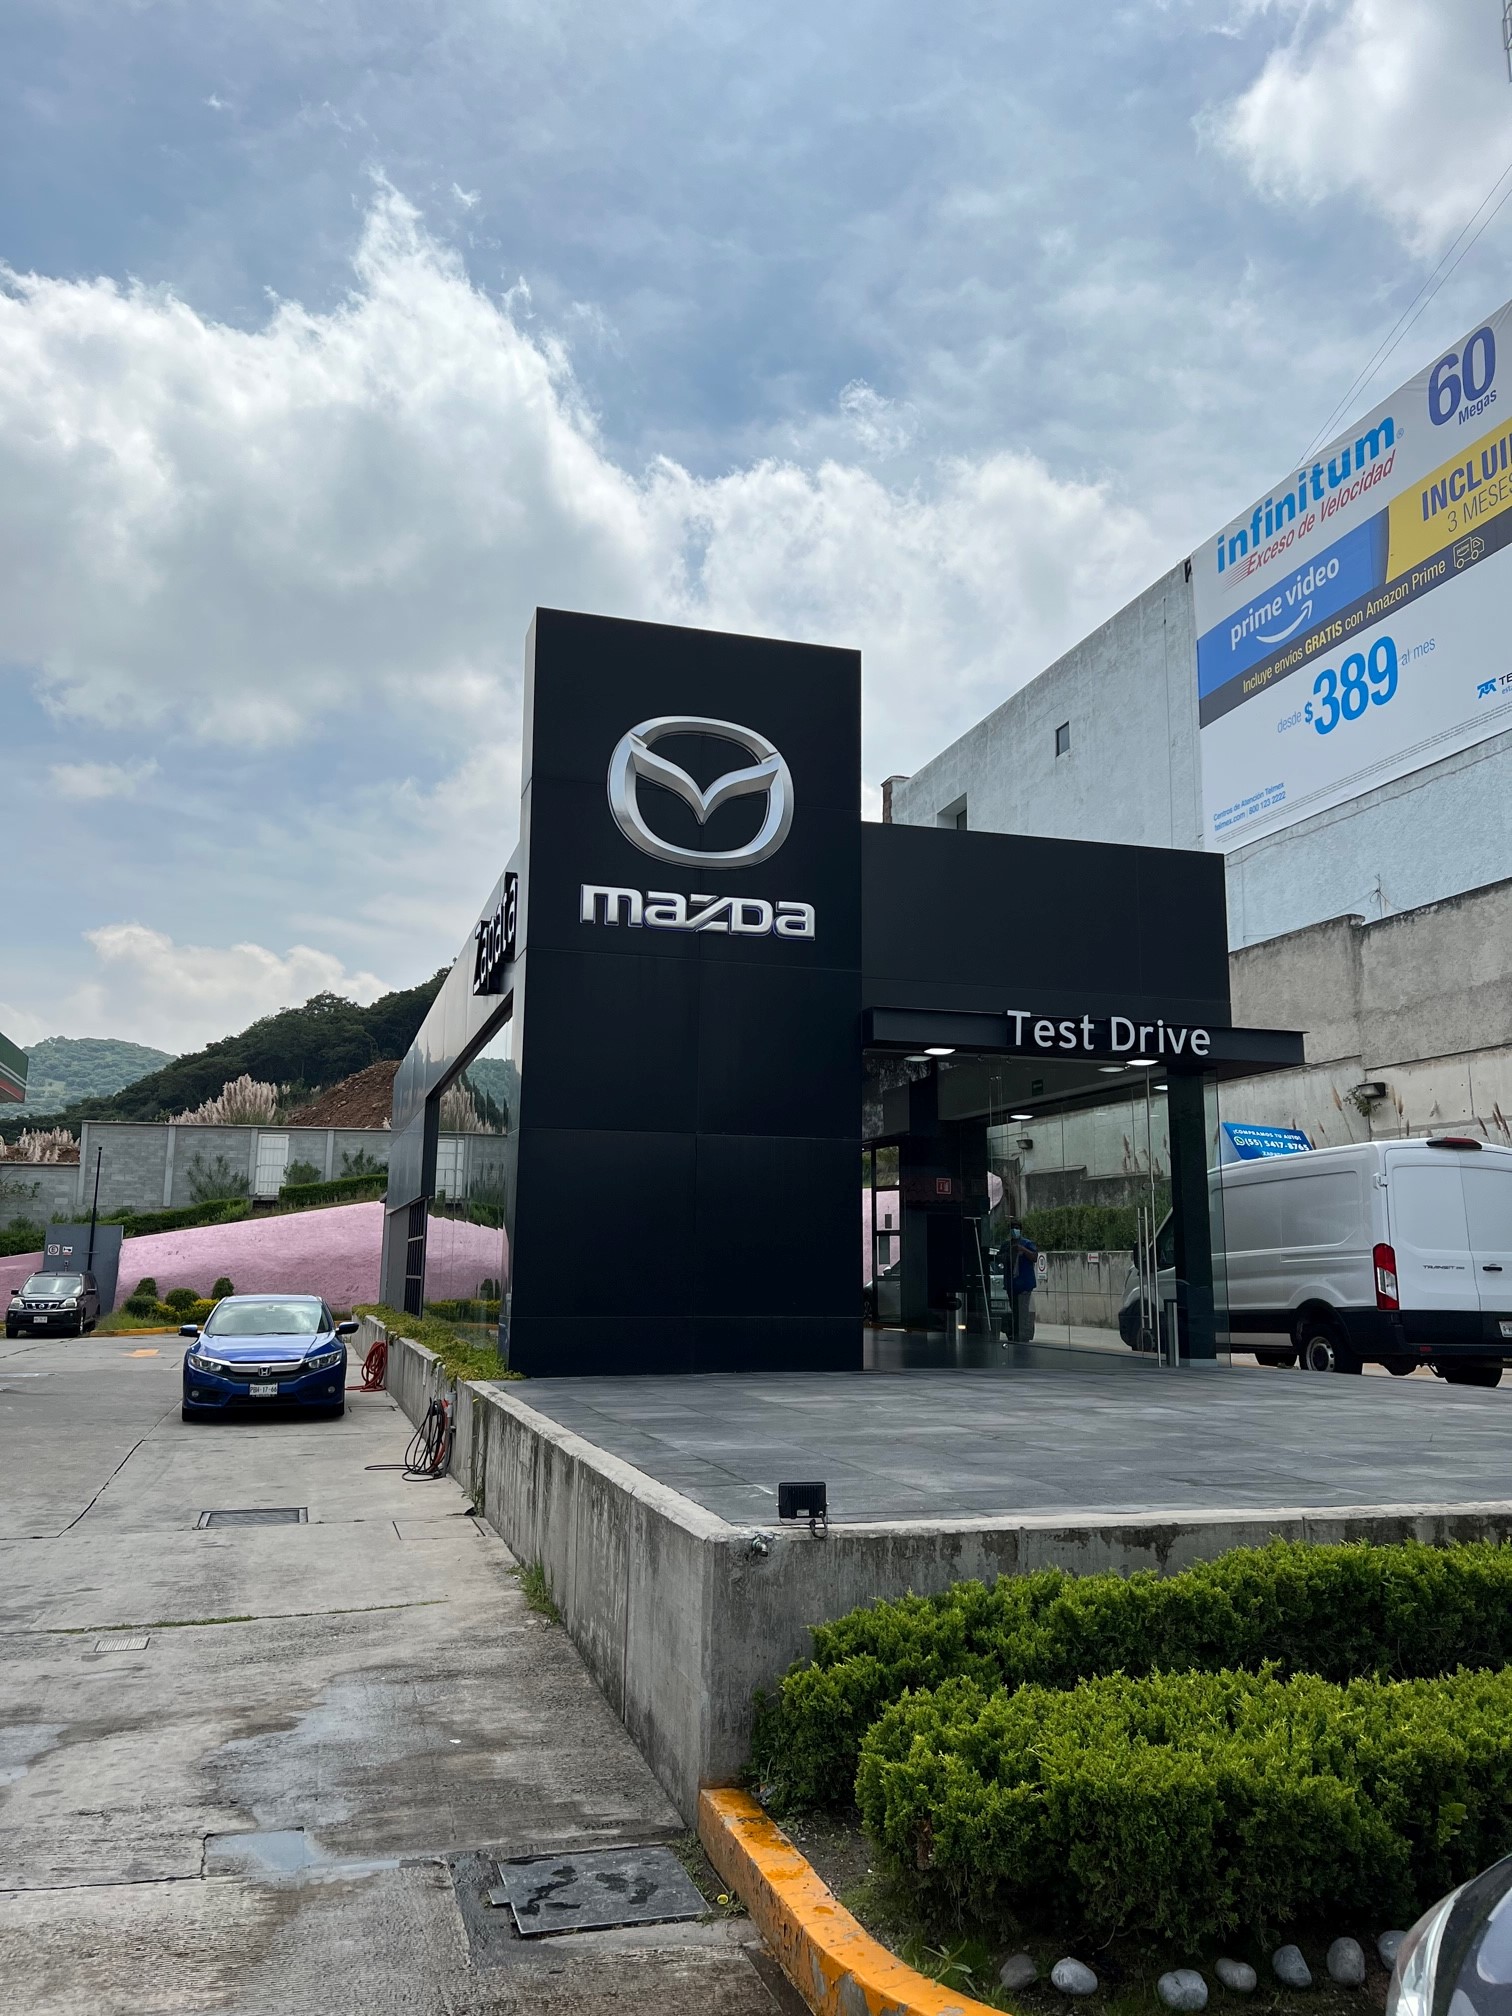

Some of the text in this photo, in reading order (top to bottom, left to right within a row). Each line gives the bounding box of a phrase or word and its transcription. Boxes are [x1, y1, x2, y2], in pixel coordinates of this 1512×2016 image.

[1428, 326, 1497, 426] 60
[1458, 389, 1498, 425] Megas
[1217, 416, 1396, 574] infinitum
[1247, 448, 1397, 575] Exceso de Velocidad
[1421, 432, 1512, 522] INCLUI
[1447, 510, 1458, 533] 3
[1230, 557, 1341, 651] prime video
[1243, 560, 1447, 695] Incluye envíos GRATIS con Amazon Prime
[1276, 635, 1437, 735] desde $389 al mes
[473, 876, 518, 996] Zapata
[1006, 1009, 1211, 1057] Test Drive
